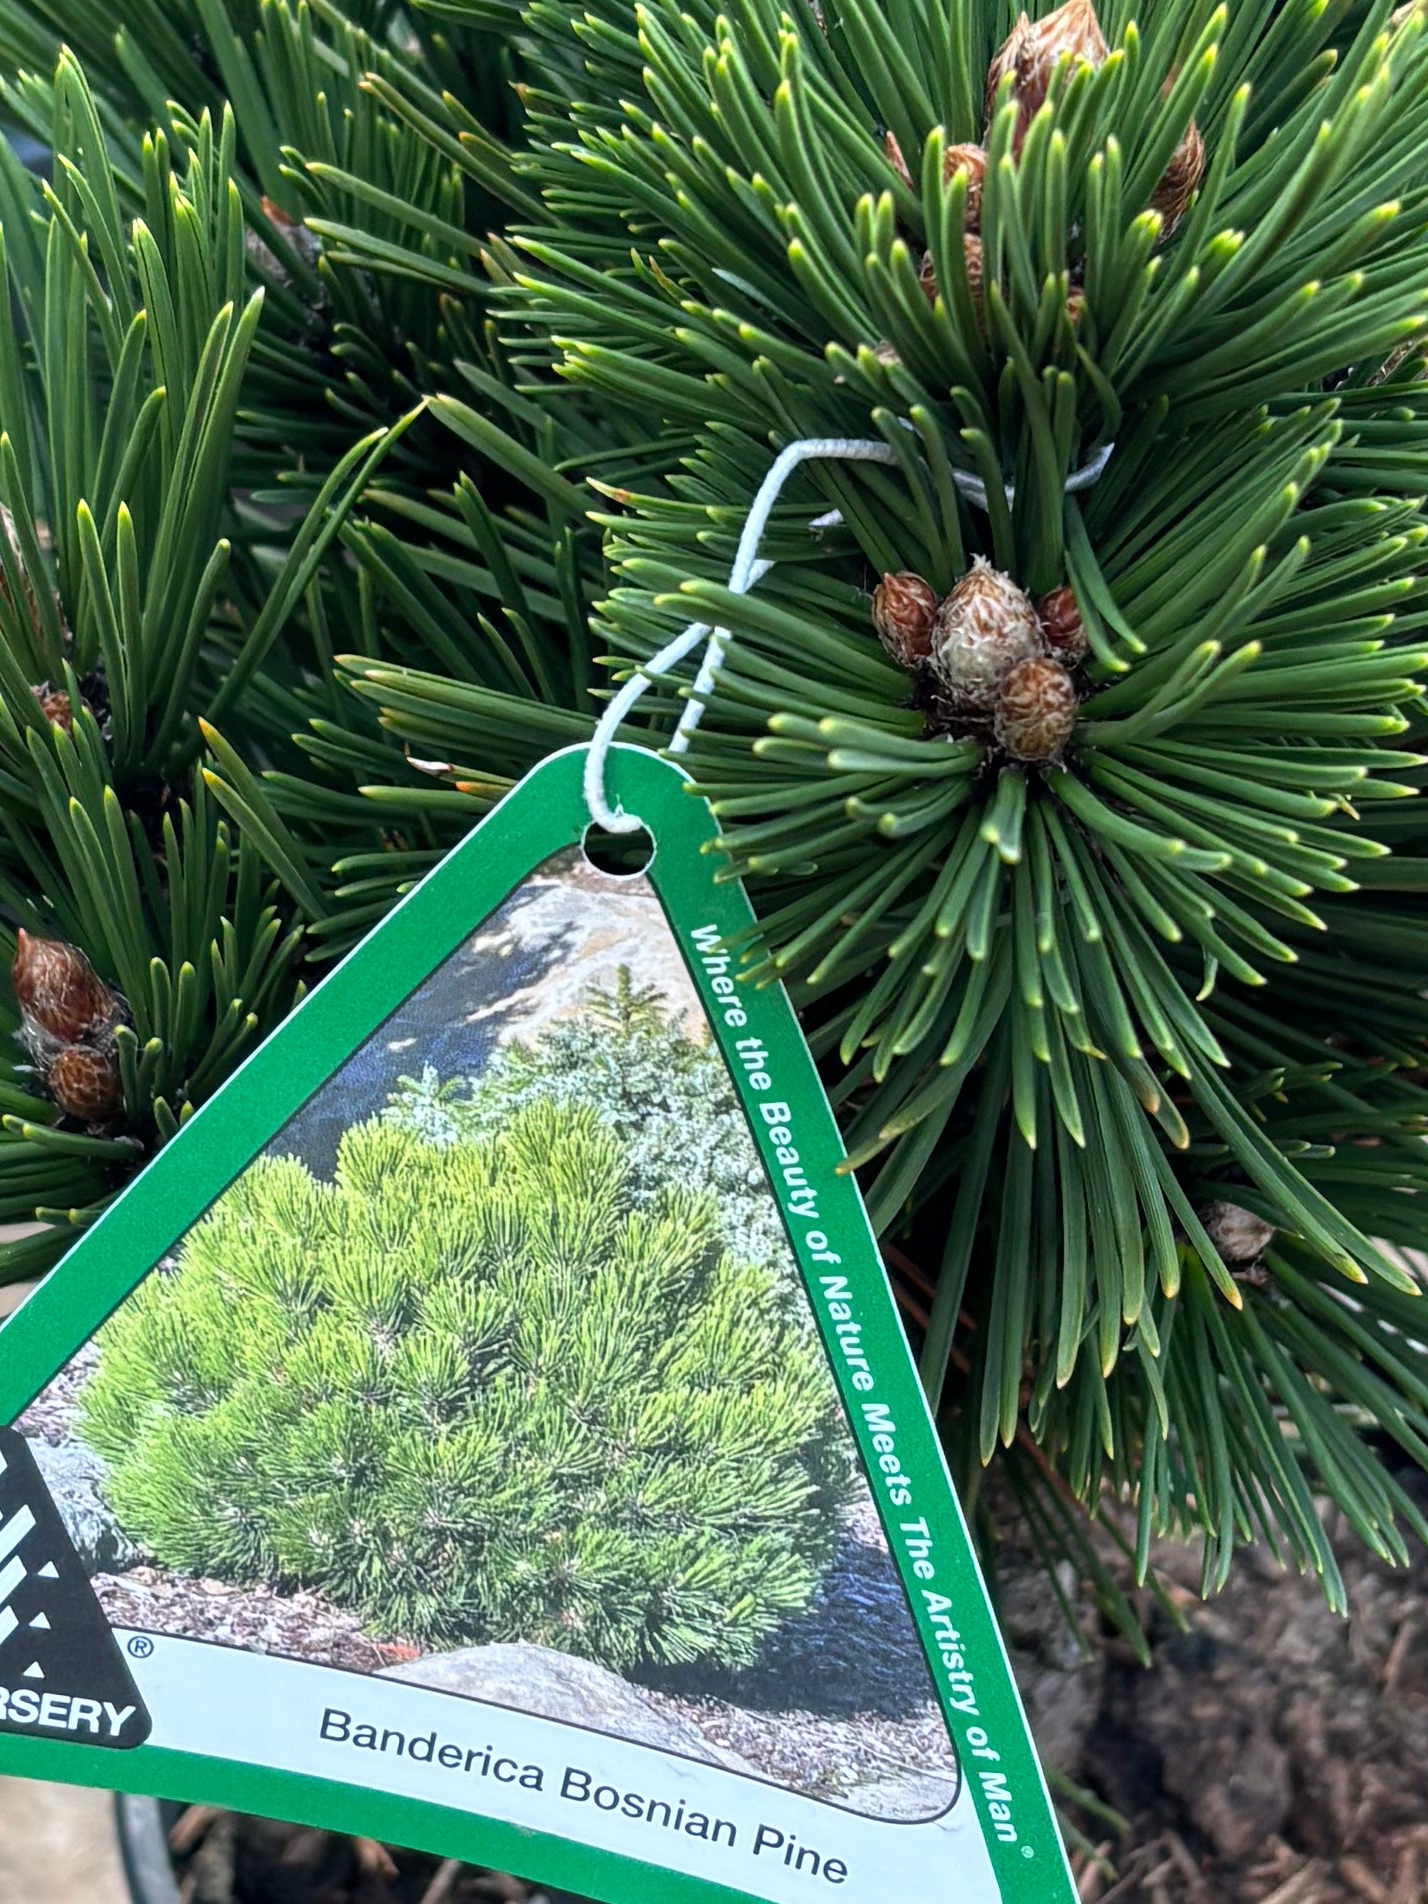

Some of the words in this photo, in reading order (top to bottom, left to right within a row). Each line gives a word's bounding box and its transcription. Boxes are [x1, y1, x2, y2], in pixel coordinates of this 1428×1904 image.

[690, 924, 748, 1027] Where
[735, 1036, 772, 1091] the
[759, 1101, 820, 1219] Beauty
[805, 1230, 842, 1265] of
[819, 1275, 875, 1392] Nature
[862, 1403, 912, 1506] Meets
[899, 1516, 936, 1580] The
[921, 1589, 979, 1716] Artistry
[966, 1726, 1000, 1762] of
[319, 1707, 544, 1792] Banderica
[560, 1767, 738, 1847] Bosnian
[752, 1823, 849, 1885] Pine
